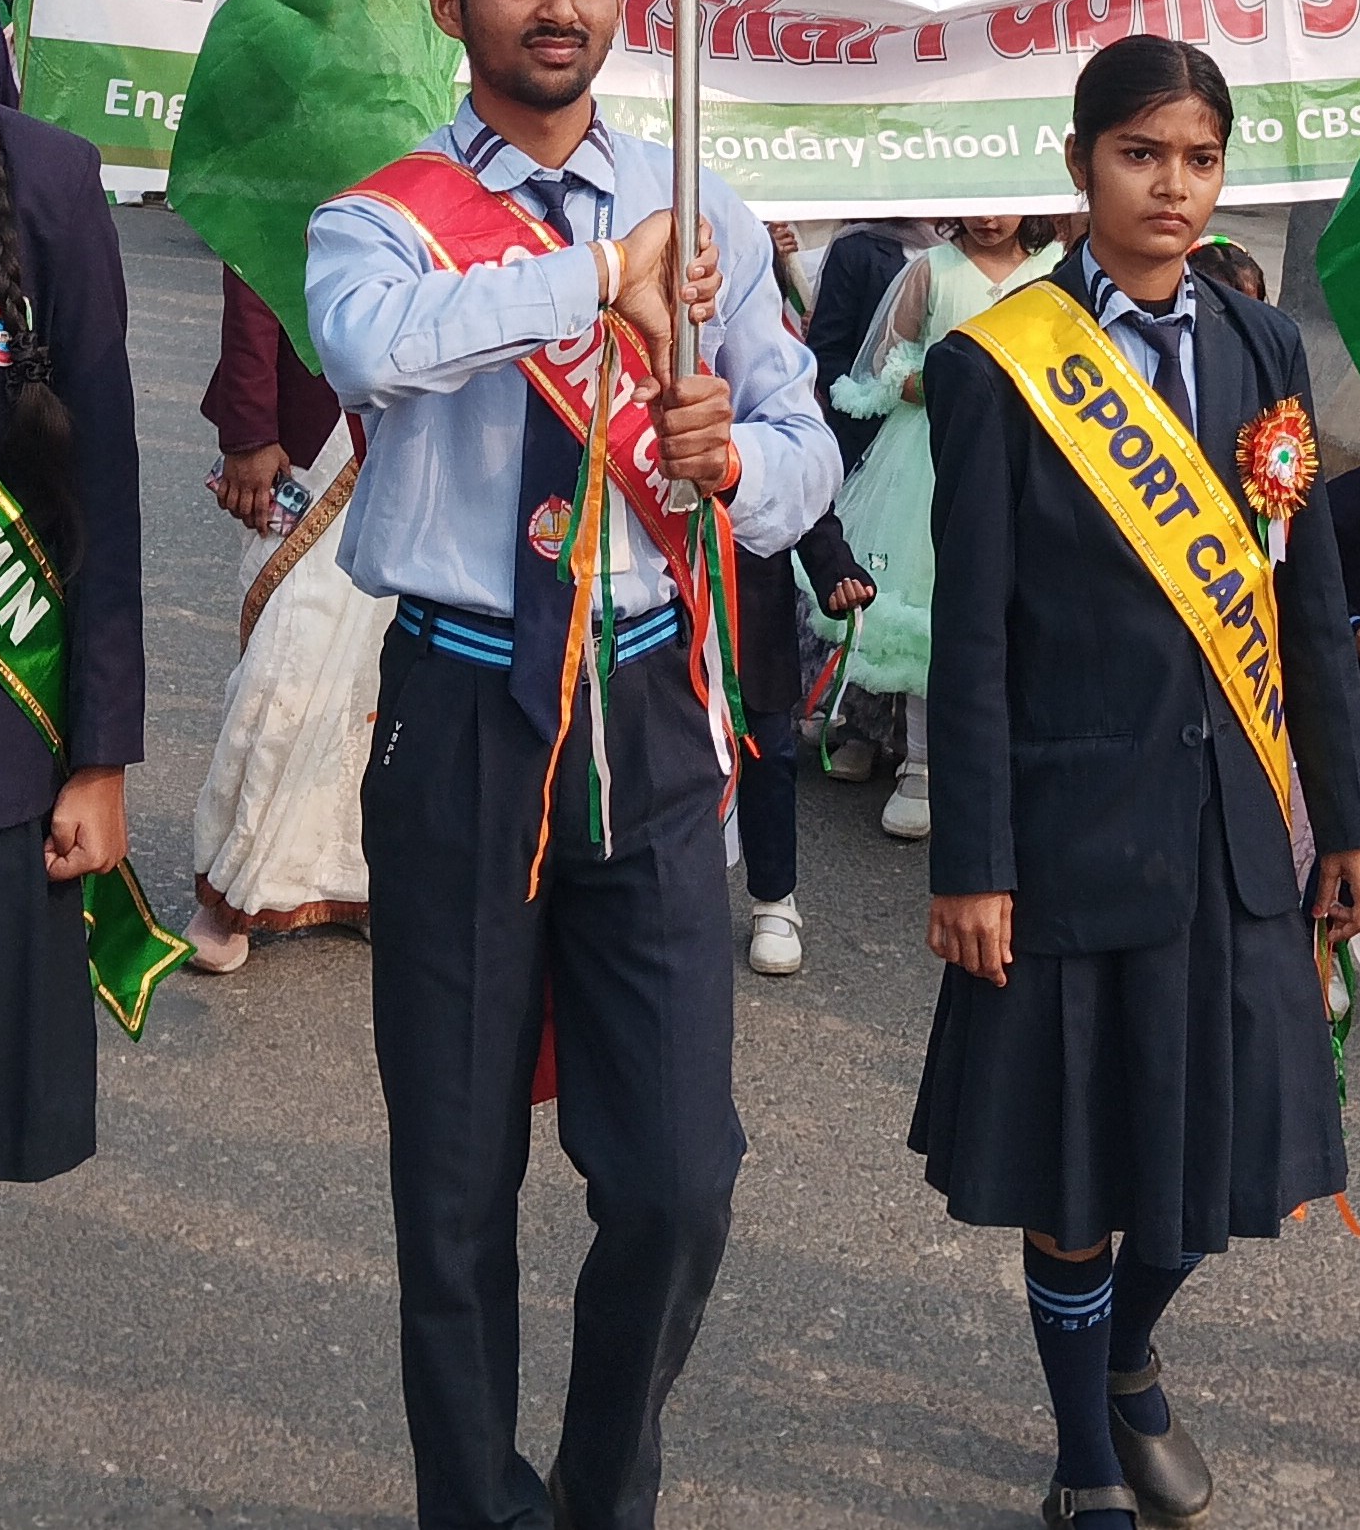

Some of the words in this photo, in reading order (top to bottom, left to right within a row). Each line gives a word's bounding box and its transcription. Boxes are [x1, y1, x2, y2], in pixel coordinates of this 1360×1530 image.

[106, 78, 184, 131] Eng
[879, 124, 1020, 161] School
[1237, 115, 1283, 145] to
[1046, 353, 1201, 528] SPORT
[1186, 531, 1287, 743] CAPTAIN
